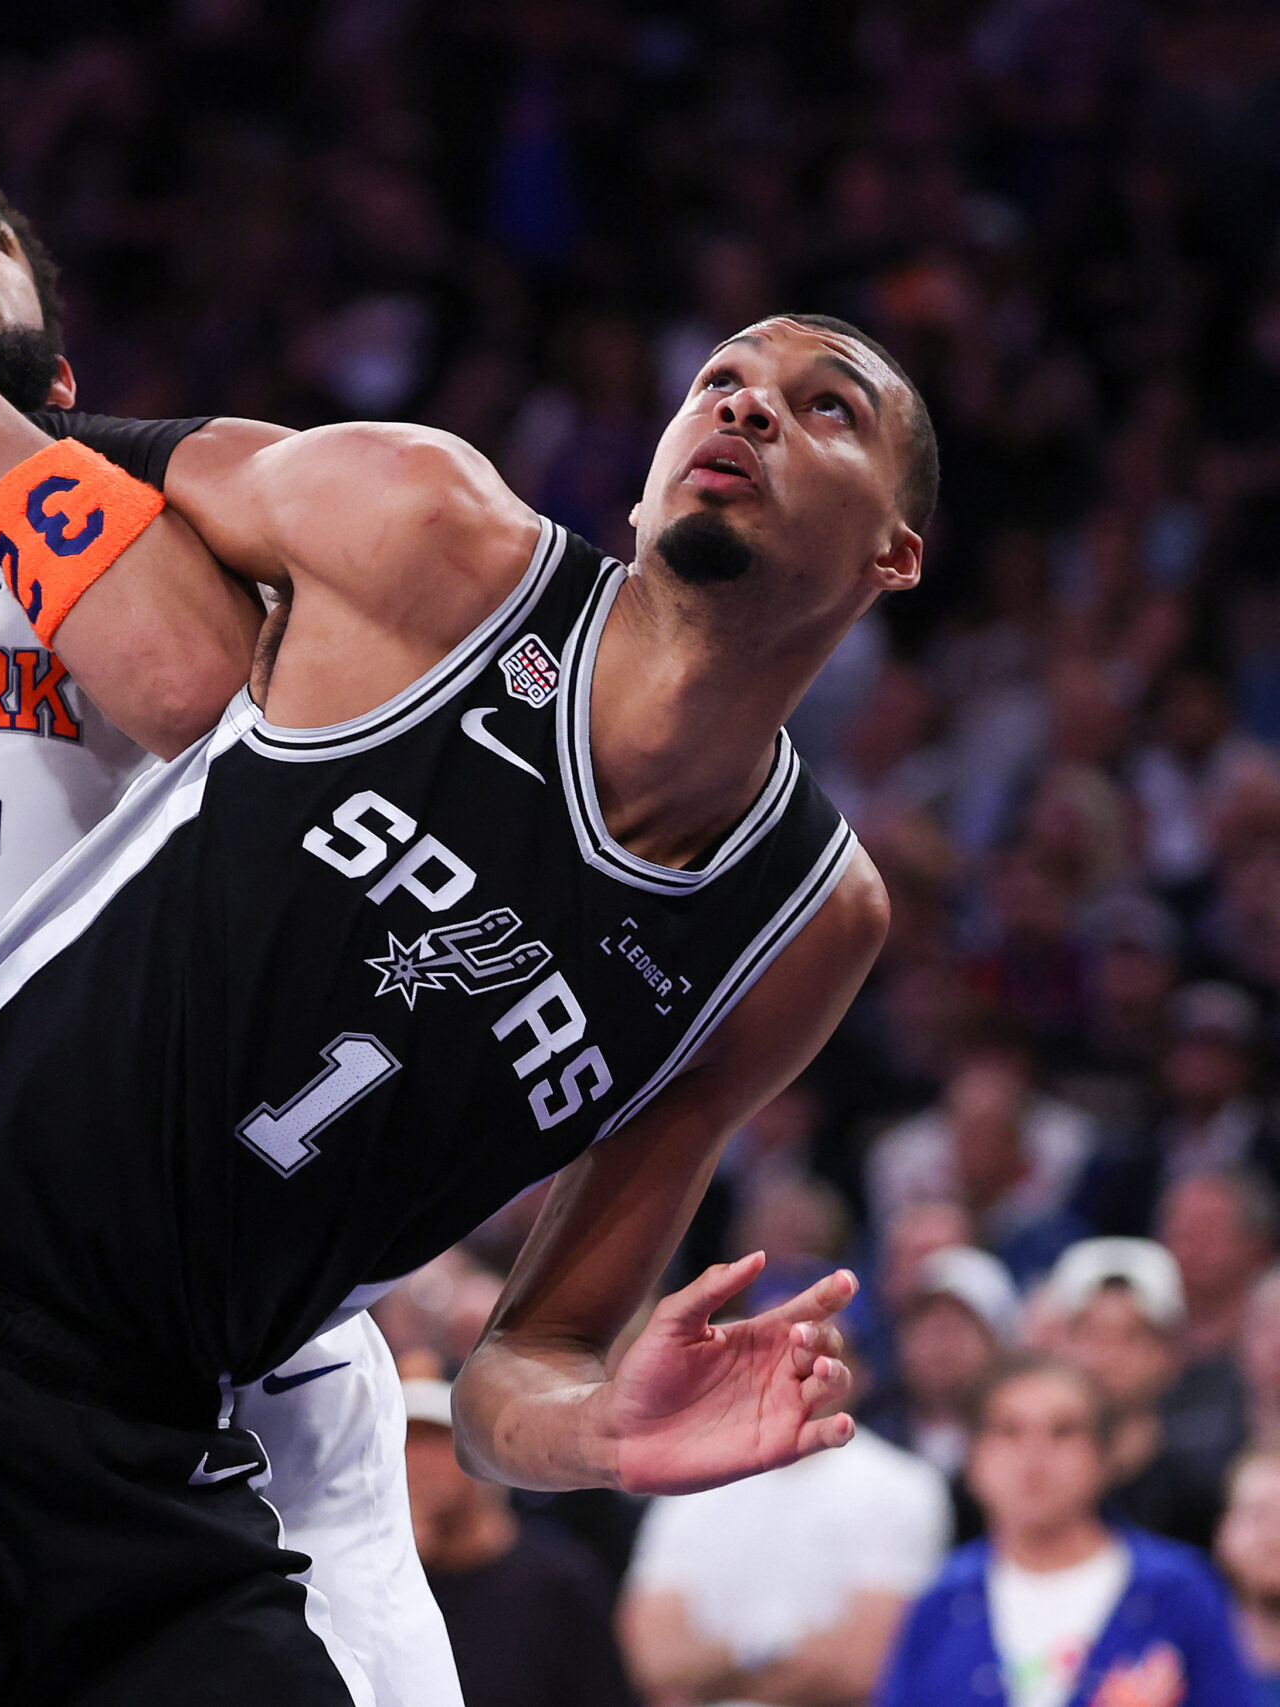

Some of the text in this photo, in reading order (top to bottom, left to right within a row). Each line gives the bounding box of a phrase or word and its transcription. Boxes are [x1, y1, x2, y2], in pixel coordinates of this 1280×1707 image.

[504, 656, 546, 703] 250
[524, 642, 557, 687] USA
[301, 789, 614, 1132] SPURS
[617, 934, 673, 998] LEDGER
[234, 1031, 403, 1179] 1
